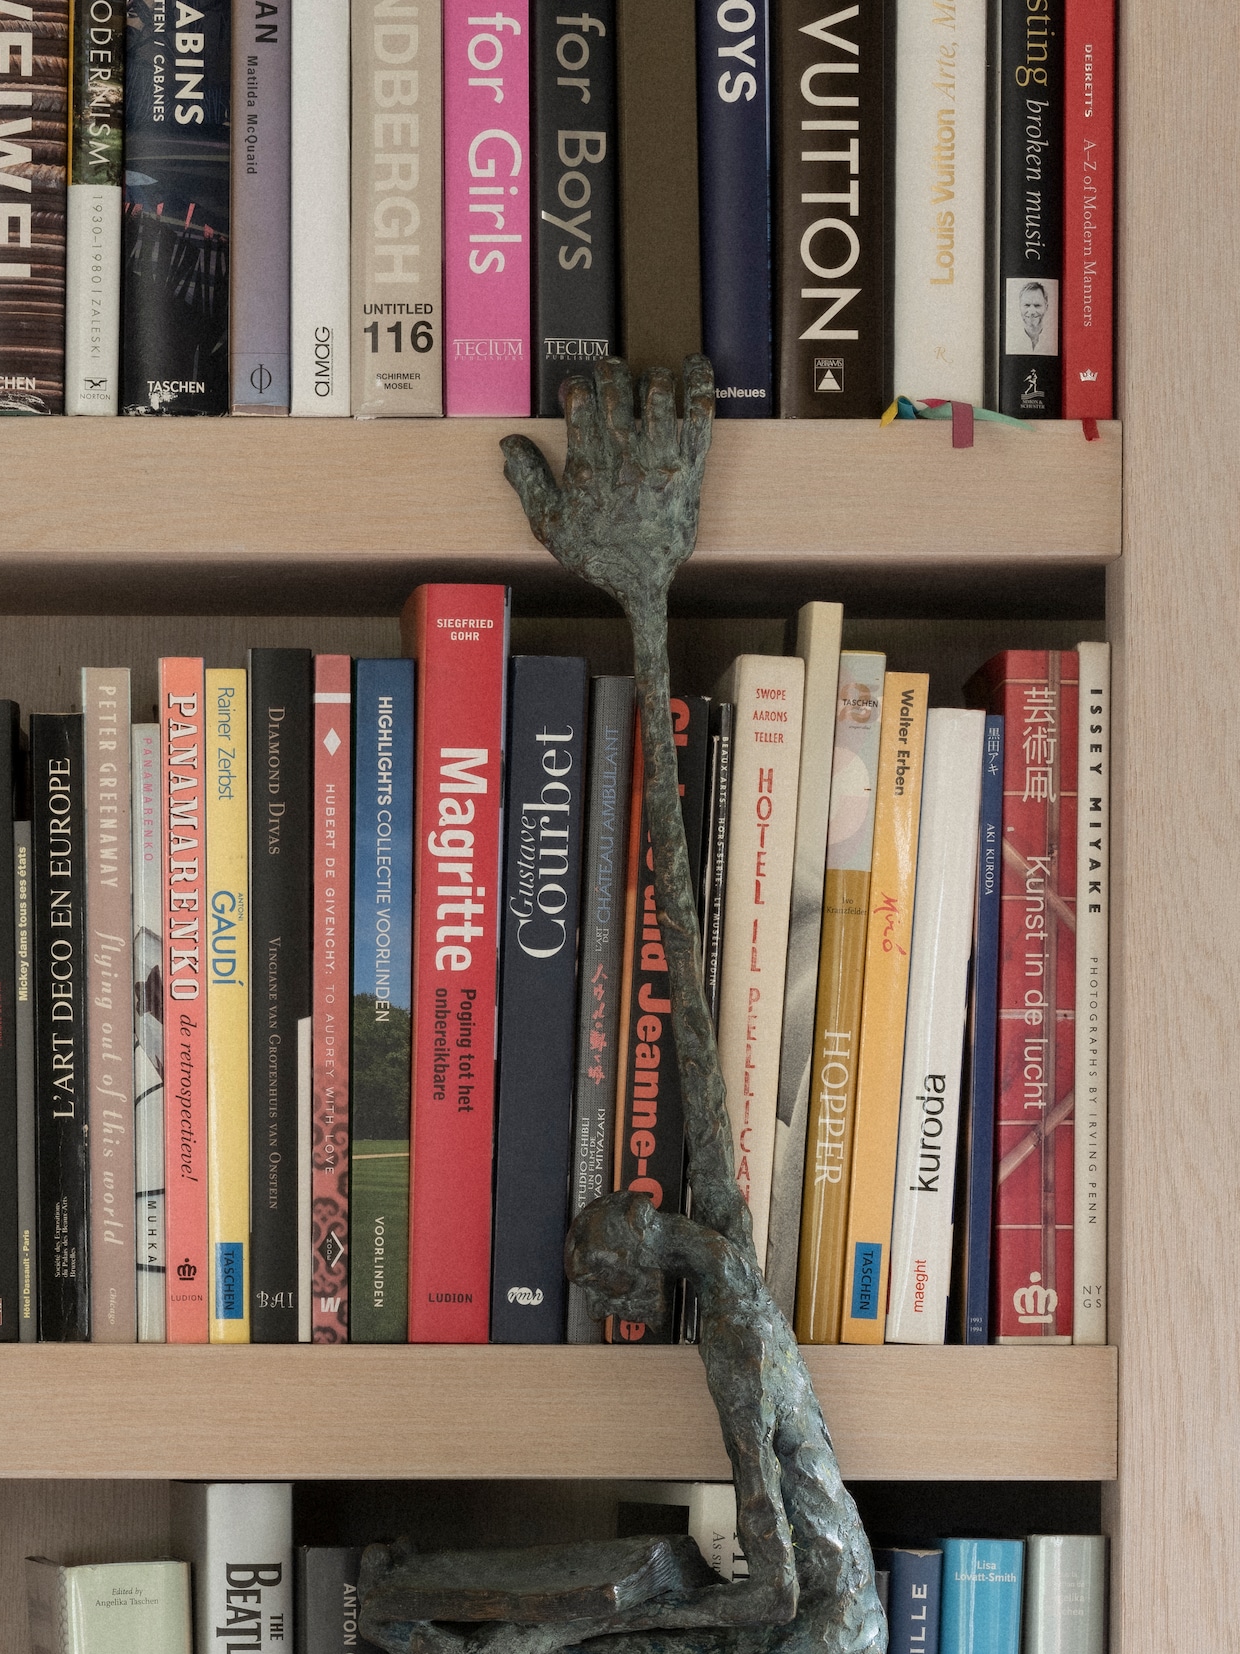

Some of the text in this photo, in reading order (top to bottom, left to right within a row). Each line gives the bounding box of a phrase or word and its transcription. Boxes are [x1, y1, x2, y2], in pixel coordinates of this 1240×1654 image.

[245, 55, 259, 175] Matilda McQuaid
[466, 12, 523, 275] for Girls
[540, 12, 607, 271] for Boys
[797, 3, 863, 340] VUITTON
[1024, 99, 1051, 260] broken music
[1082, 43, 1098, 328] DEBRETT'S Modern Manners
[363, 303, 433, 315] UNTITLED
[363, 320, 434, 353] 116
[436, 619, 494, 629] SIEGFRIED
[450, 632, 481, 641] GOHR
[97, 685, 118, 888] PETER GREENAWAY
[142, 736, 155, 863] PANAMARENKO
[217, 686, 236, 801] Rainer Zerbst
[894, 689, 915, 796] Walter Erben
[1088, 688, 1103, 914] ISSEY MIYAKE
[167, 691, 202, 1001] PANAMARENKO
[374, 695, 394, 1023] HIGHLIGHTS COLLECTIE VOORLINDEN
[427, 747, 489, 972] Magritte
[516, 724, 574, 959] Courbet
[48, 758, 75, 1120] L'ART DECO EUROPE
[211, 890, 244, 988] GAUDÍ
[1023, 855, 1051, 1110] Kunst in de lucht
[432, 987, 451, 1101] onbereikbare
[455, 987, 478, 1048] Poging
[177, 1042, 199, 1182] retrospectieve!
[813, 1028, 852, 1187] HOPPER
[909, 1073, 946, 1193] kuroda
[146, 1200, 158, 1264] MUHKA
[373, 1215, 386, 1308] VOORLINDEN
[913, 1259, 928, 1313] maeght
[343, 1582, 358, 1646] ANTON
